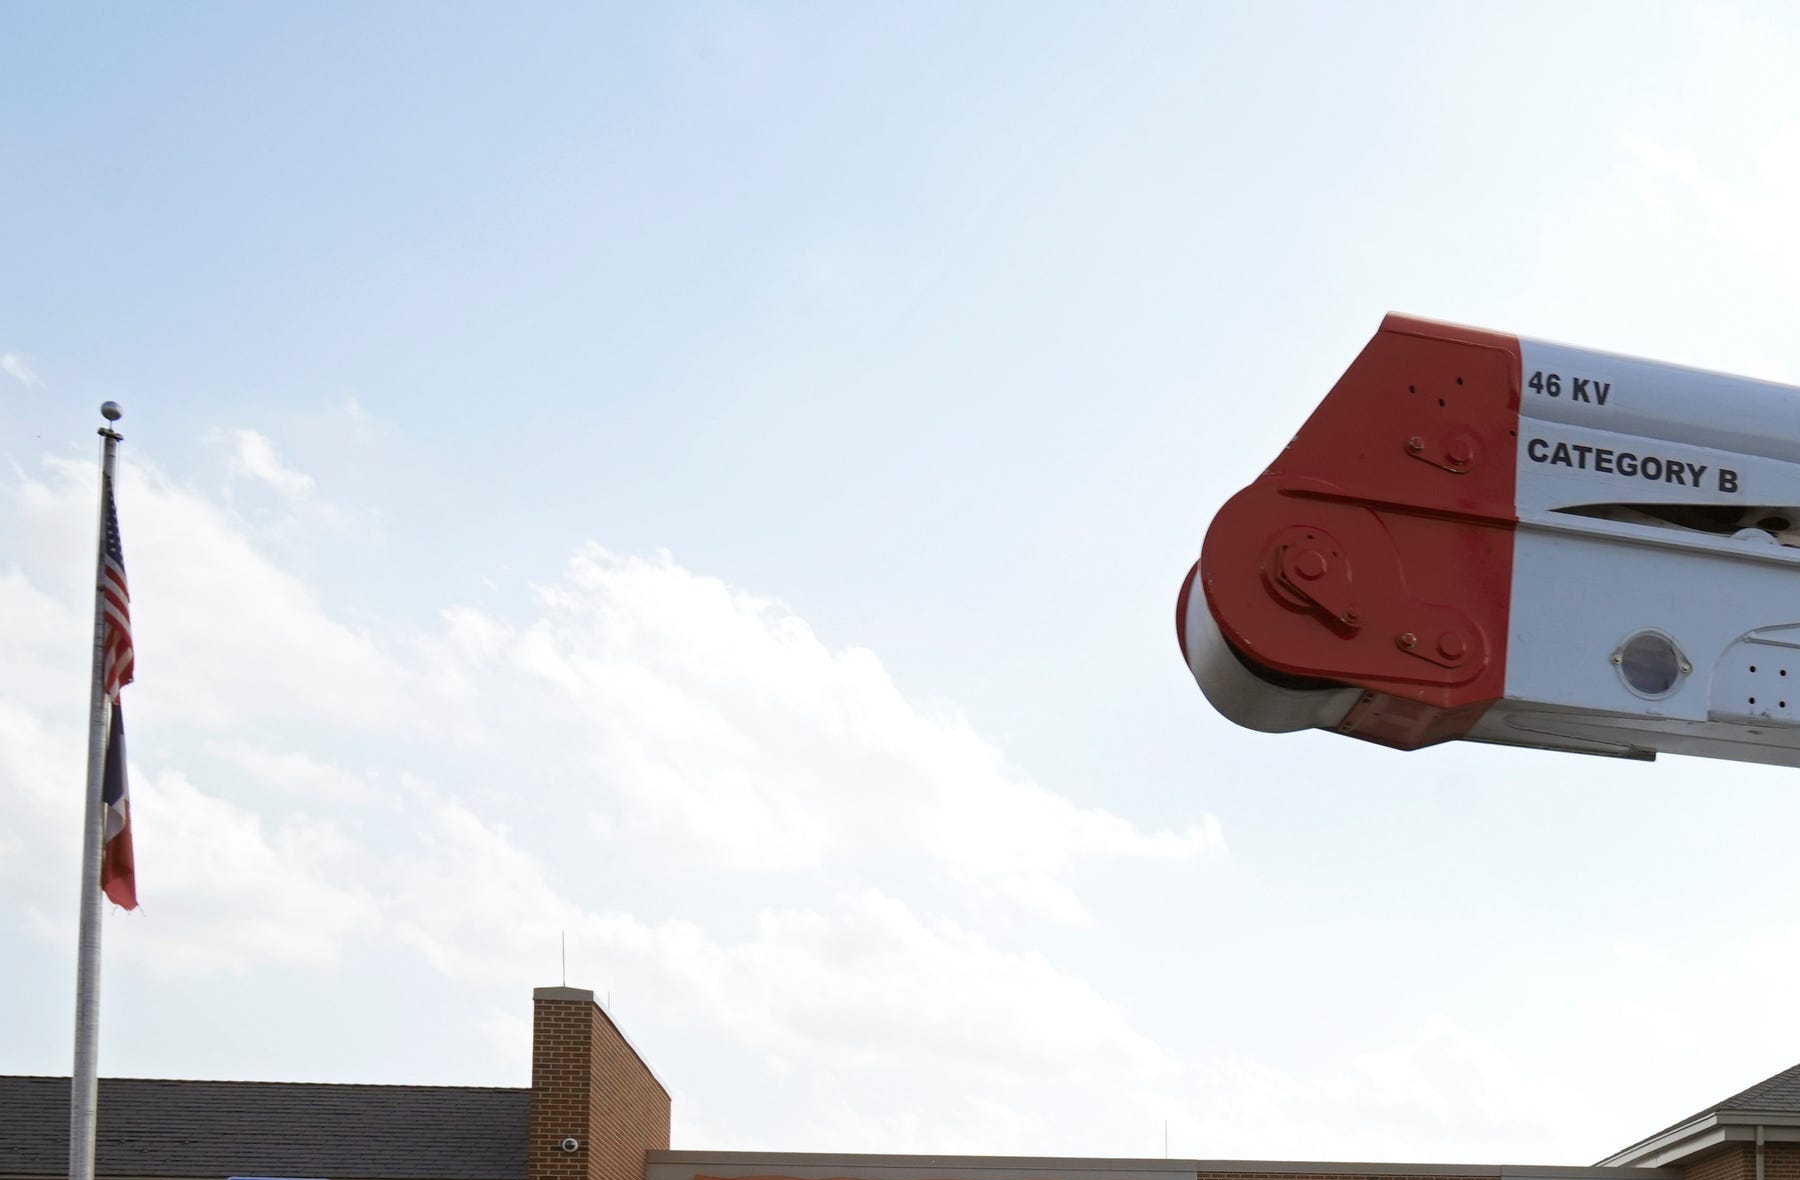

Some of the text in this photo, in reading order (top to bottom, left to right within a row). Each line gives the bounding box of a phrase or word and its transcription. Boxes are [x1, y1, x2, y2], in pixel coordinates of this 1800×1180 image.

[1528, 371, 1611, 406] 46 KV
[1527, 438, 1738, 493] CATEGORY B
